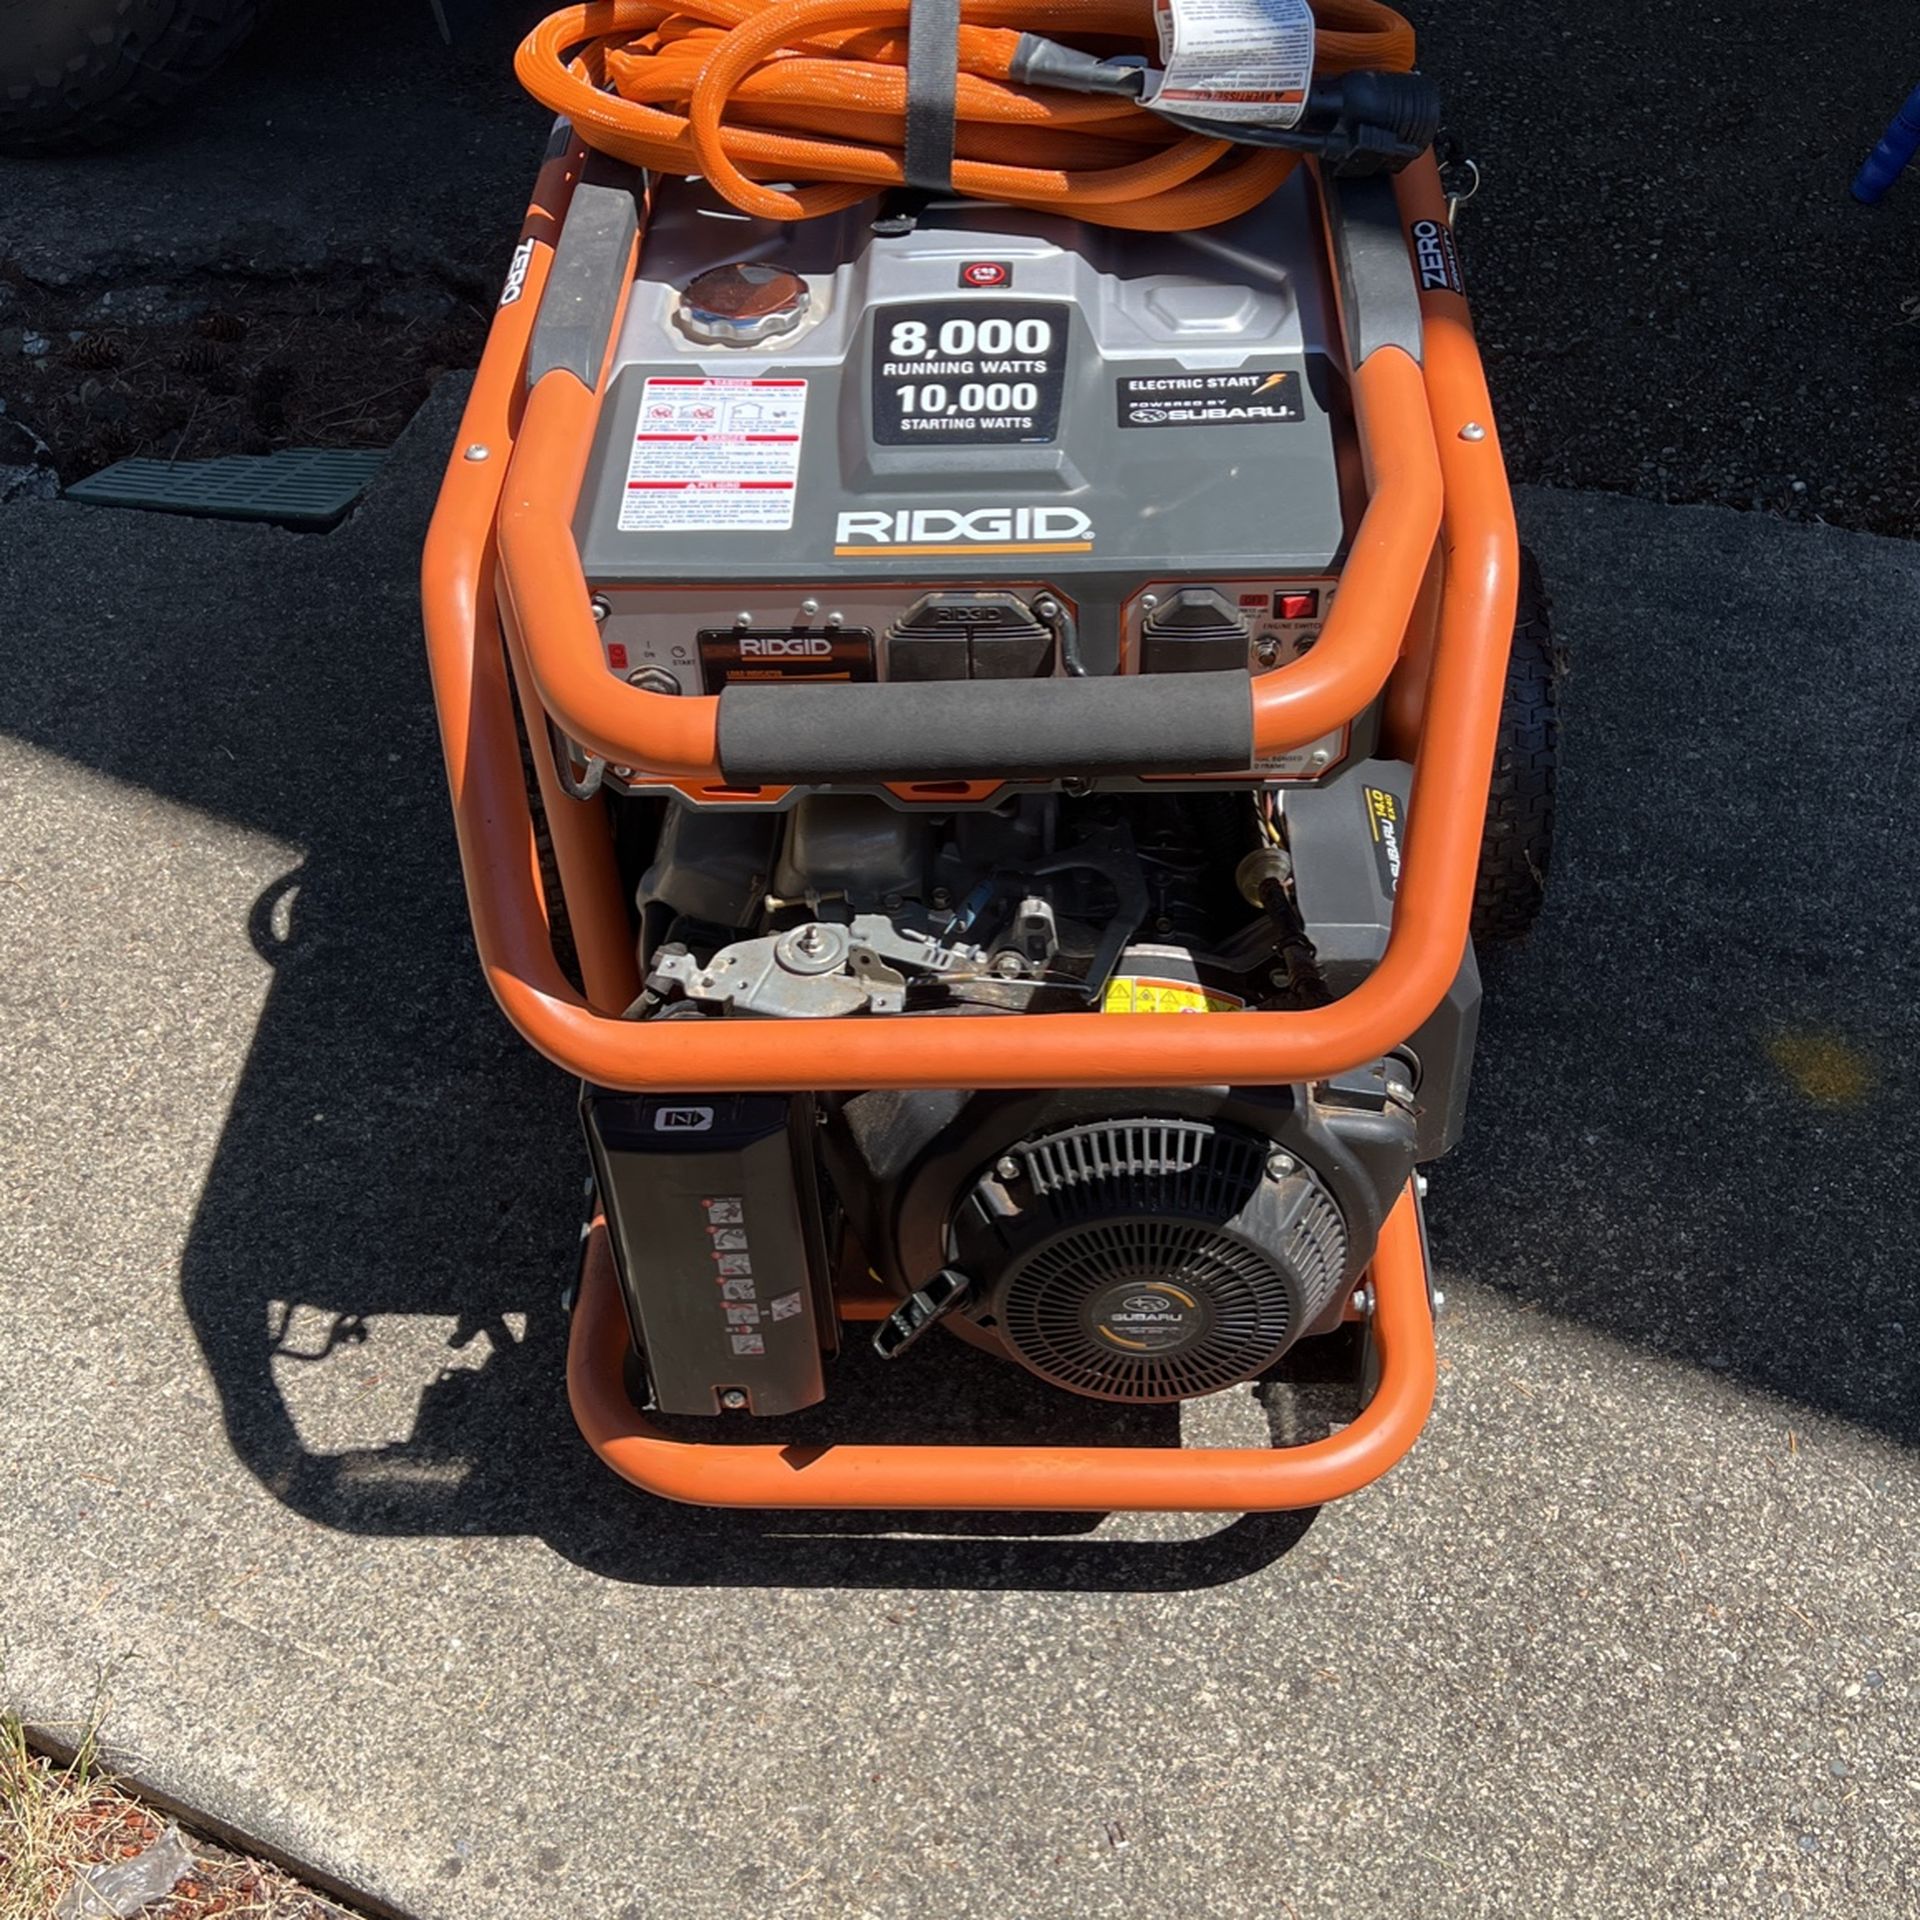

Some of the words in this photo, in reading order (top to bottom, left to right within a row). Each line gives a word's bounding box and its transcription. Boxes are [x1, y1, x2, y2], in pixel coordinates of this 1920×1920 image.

[1414, 221, 1448, 288] ZERO
[500, 237, 535, 305] ZERO
[889, 319, 1051, 360] 8,000
[882, 361, 974, 376] RUNNING
[981, 360, 1047, 374] WATTS
[1129, 378, 1202, 391] ELECTRIC
[1207, 376, 1259, 388] START
[896, 382, 1038, 415] 10,000
[1129, 400, 1203, 408] POWERED
[1168, 406, 1287, 421] SUBARU
[900, 418, 976, 431] STARTING
[980, 417, 1032, 429] WATTS
[835, 506, 1093, 544] RIDGID
[739, 639, 832, 656] RIDGID
[1111, 1312, 1183, 1322] SUBARU
